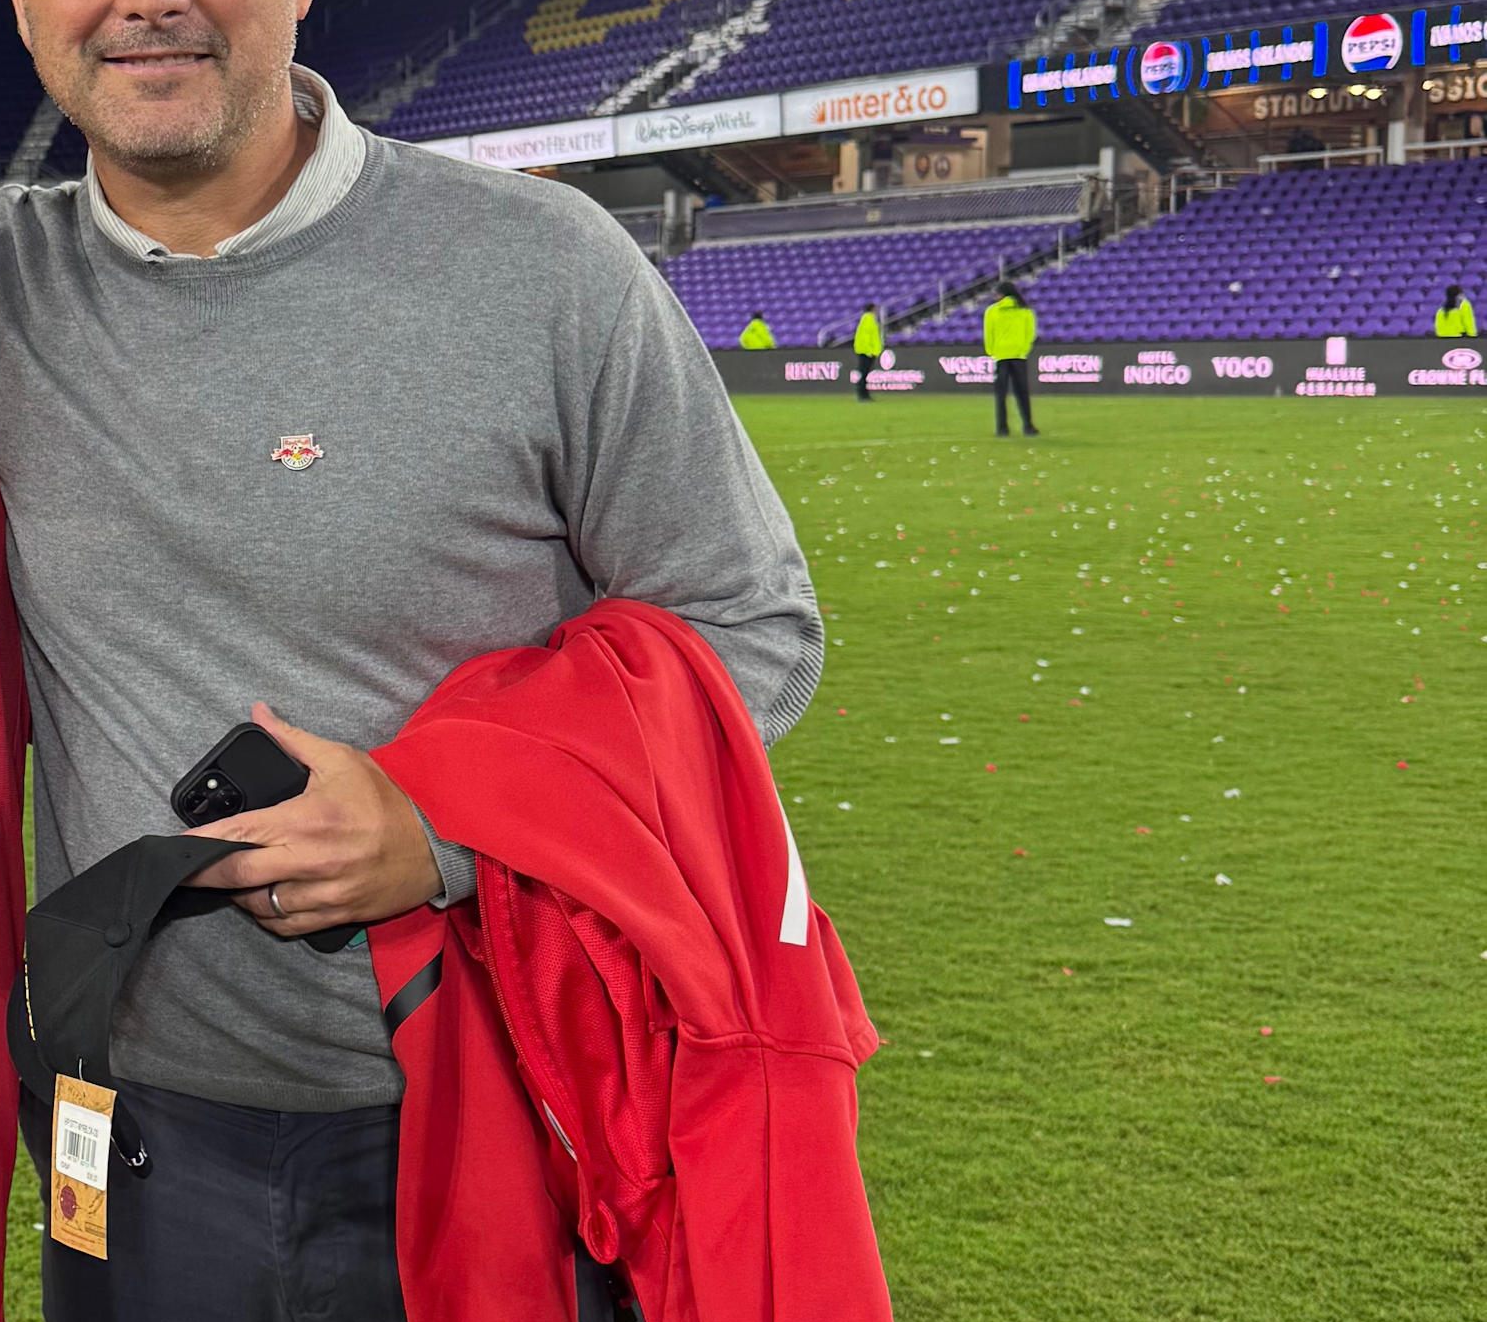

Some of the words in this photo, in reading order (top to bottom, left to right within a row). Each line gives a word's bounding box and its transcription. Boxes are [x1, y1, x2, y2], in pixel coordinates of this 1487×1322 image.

[1348, 38, 1396, 54] PEPSI
[1123, 364, 1192, 385] INDIGO
[1211, 356, 1274, 379] VOCO
